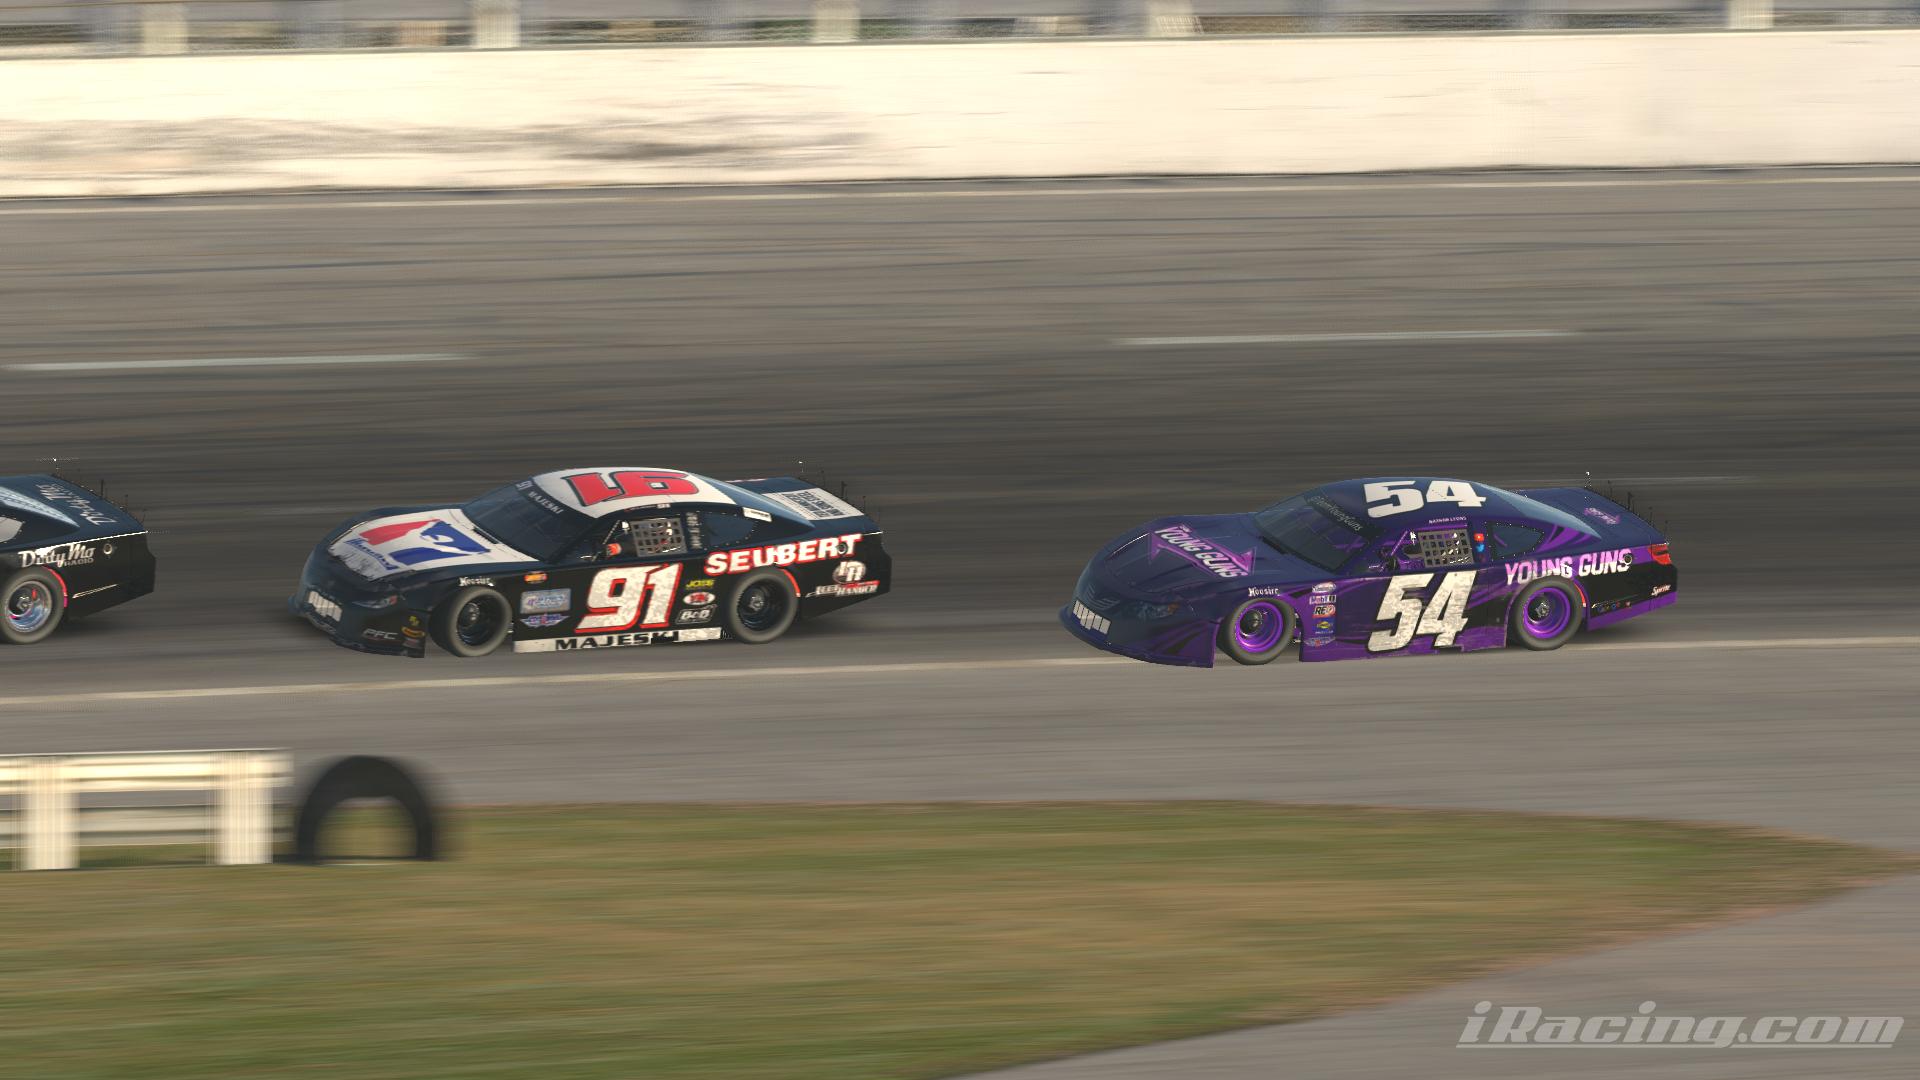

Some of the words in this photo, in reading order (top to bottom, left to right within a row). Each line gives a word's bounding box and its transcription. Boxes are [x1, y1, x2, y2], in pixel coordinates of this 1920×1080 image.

[1363, 480, 1486, 518] 54
[704, 533, 862, 576] SEUBERT
[1154, 526, 1213, 552] YOUNG
[1194, 551, 1249, 578] GUNS
[1504, 555, 1574, 585] YOUNG
[1577, 548, 1633, 577] GUNS
[575, 562, 683, 634] 91
[1367, 570, 1477, 652] 54
[555, 630, 679, 650] MAJESKI
